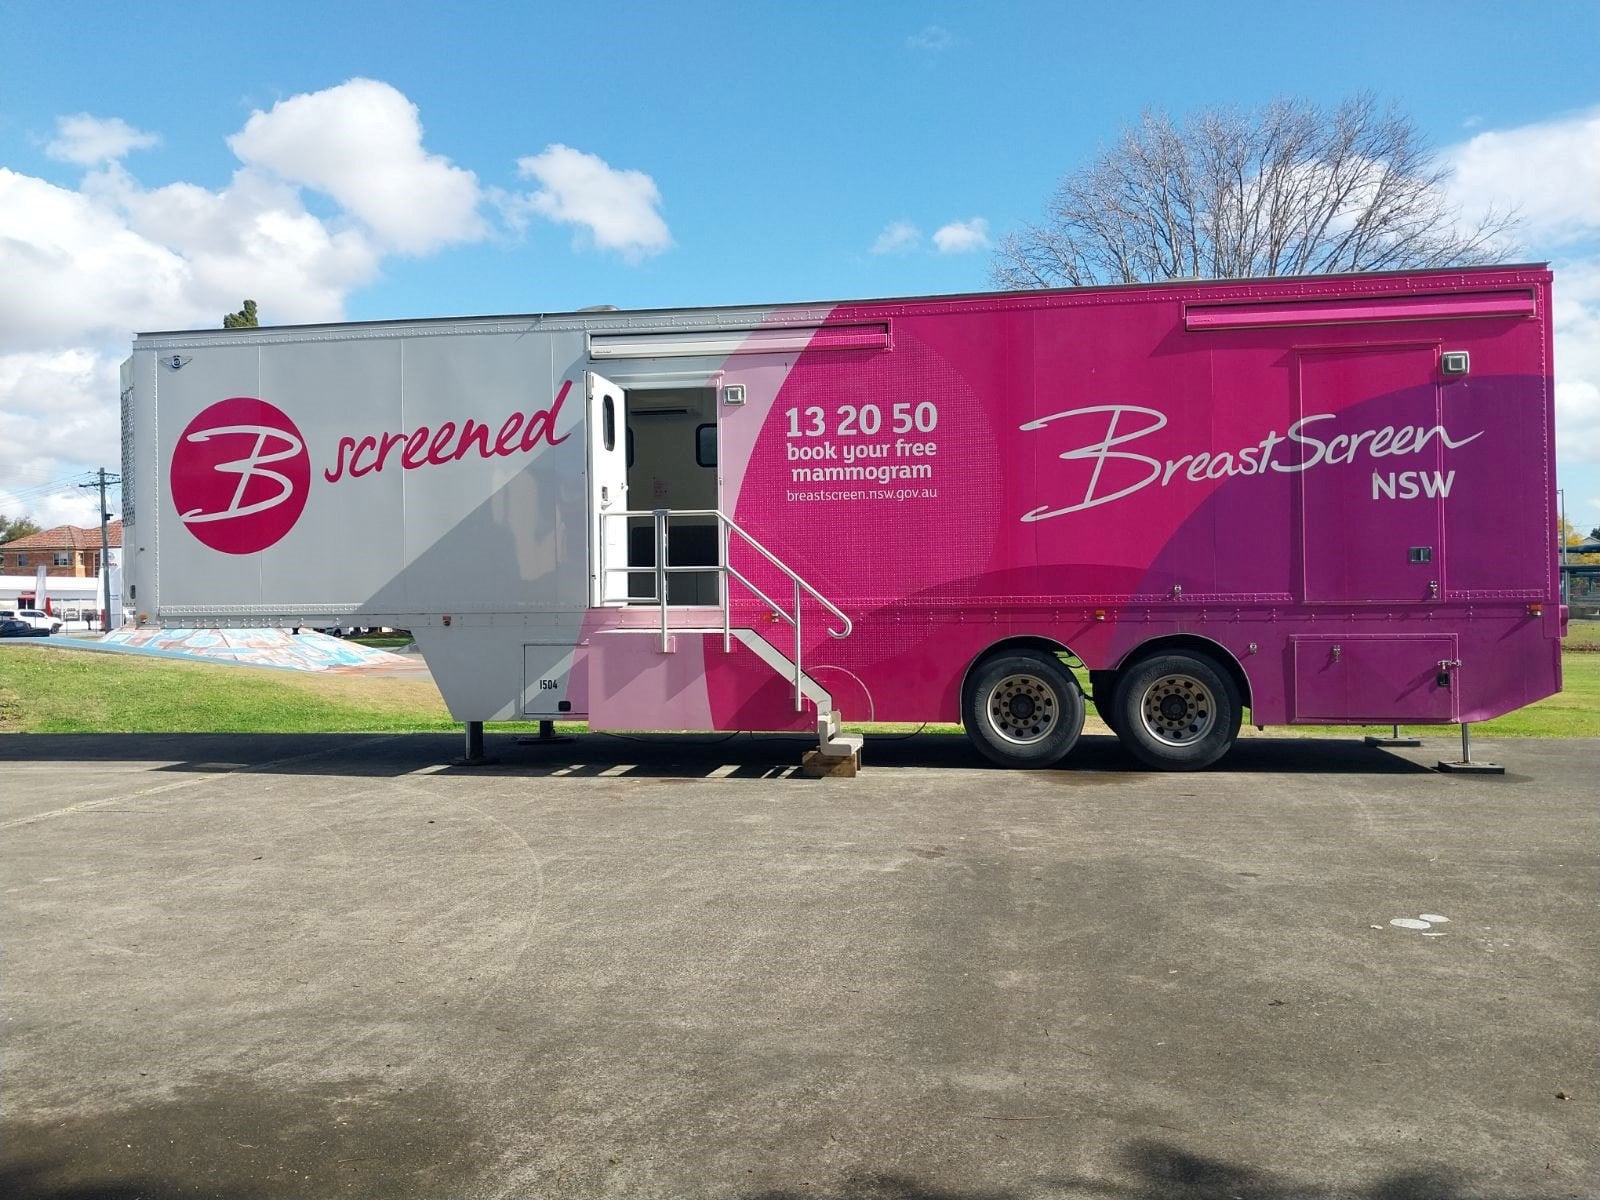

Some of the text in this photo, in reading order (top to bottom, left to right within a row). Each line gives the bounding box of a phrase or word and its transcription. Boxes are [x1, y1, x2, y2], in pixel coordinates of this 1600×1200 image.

[785, 401, 938, 437] 13 20 50
[180, 380, 572, 524] B screened
[786, 439, 937, 464] book your free
[1019, 404, 1484, 523] BreastScreen
[792, 464, 932, 484] mammogram
[1372, 469, 1456, 501] NSW
[786, 488, 938, 502] breastscreen.nsw.gov.au
[539, 679, 558, 690] 1504
